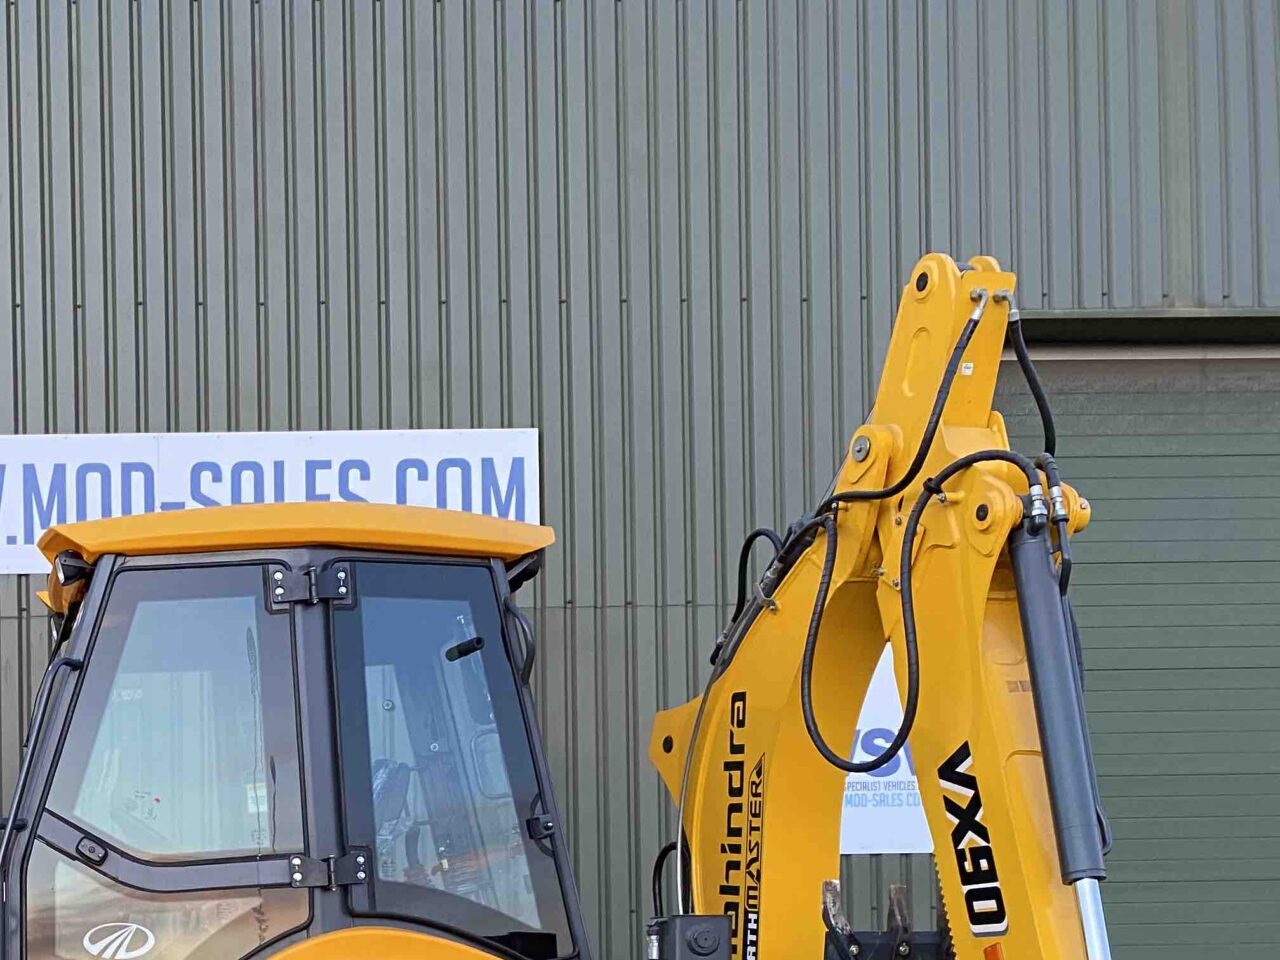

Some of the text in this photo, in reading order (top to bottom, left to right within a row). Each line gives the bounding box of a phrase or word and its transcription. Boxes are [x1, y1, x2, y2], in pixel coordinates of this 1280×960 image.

[846, 780, 916, 792] PECIALIST VEHICLES
[937, 740, 1008, 932] VX90
